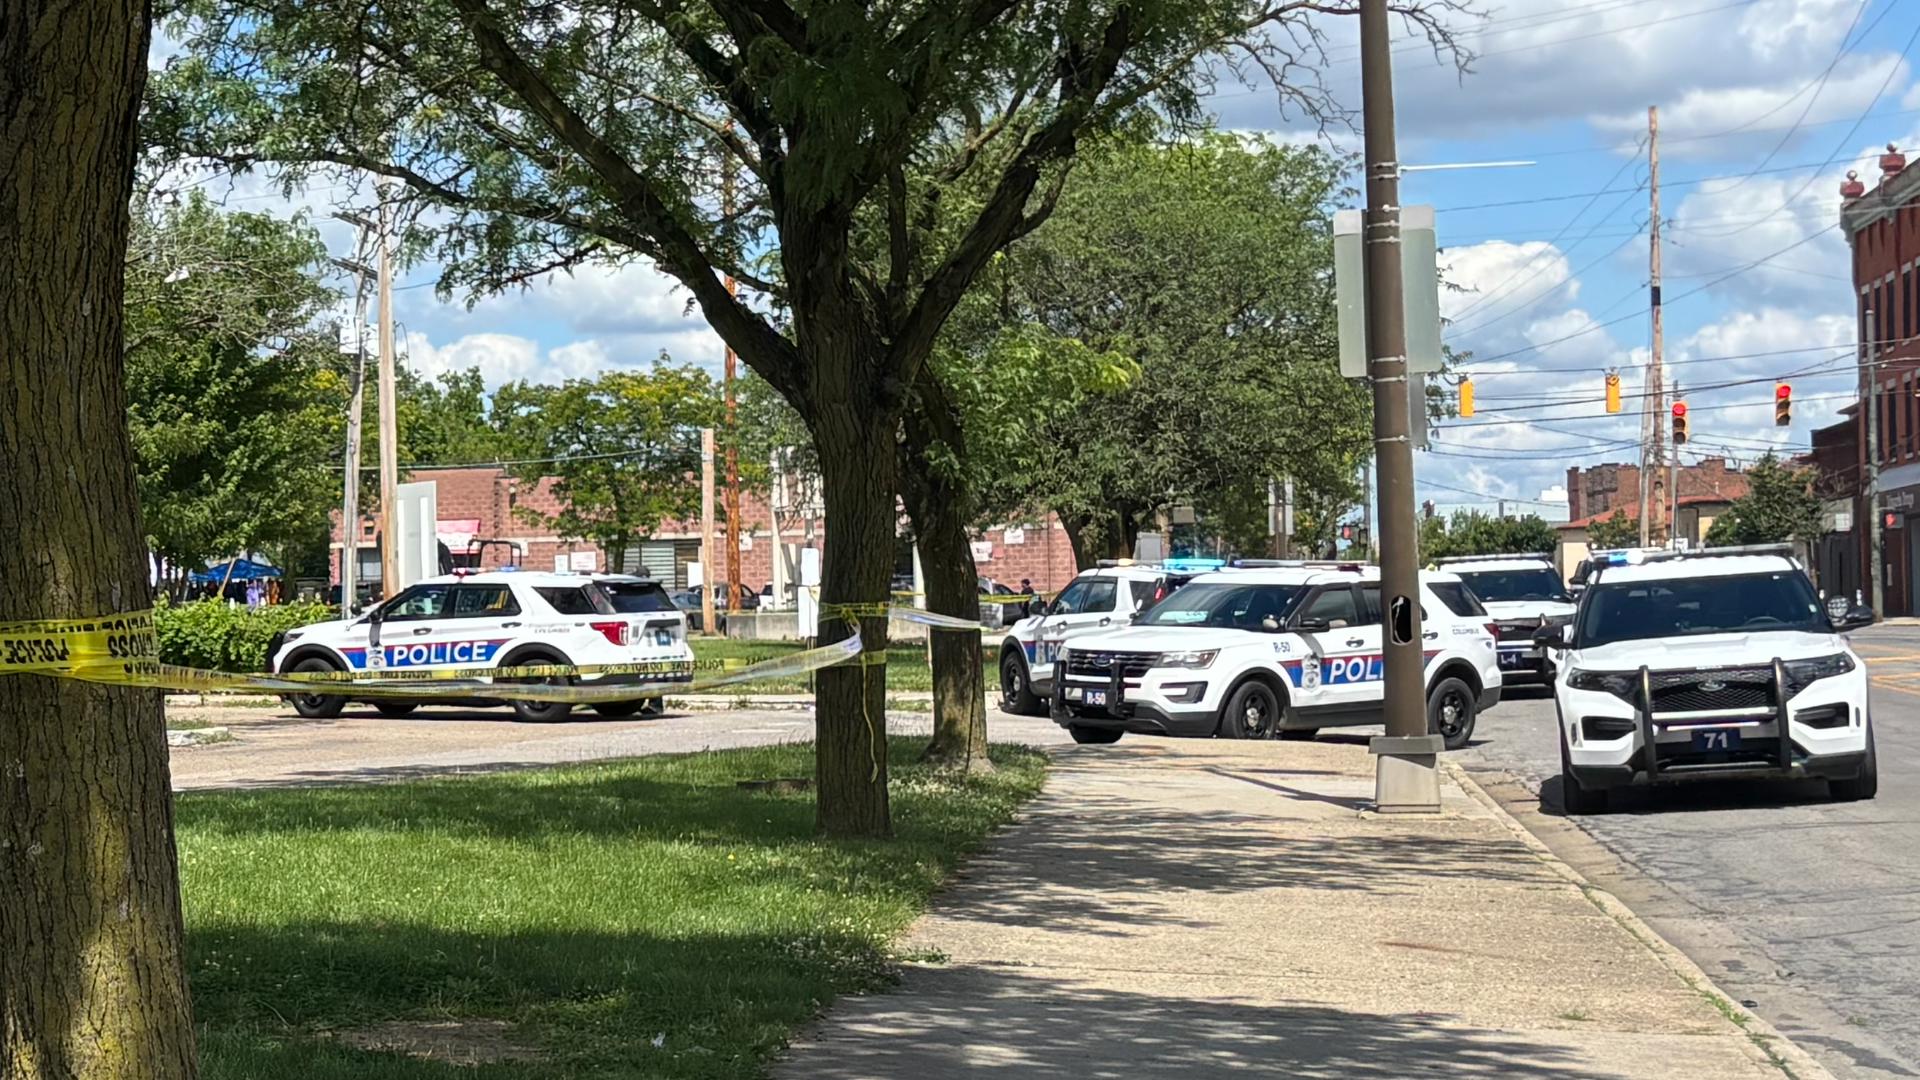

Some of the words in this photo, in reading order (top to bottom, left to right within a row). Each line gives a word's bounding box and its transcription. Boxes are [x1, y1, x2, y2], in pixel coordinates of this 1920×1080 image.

[4, 638, 70, 664] POLICE
[392, 640, 488, 666] POLICE
[1329, 656, 1384, 683] POLI
[1087, 691, 1107, 705] R-50
[1704, 731, 1728, 749] 71
